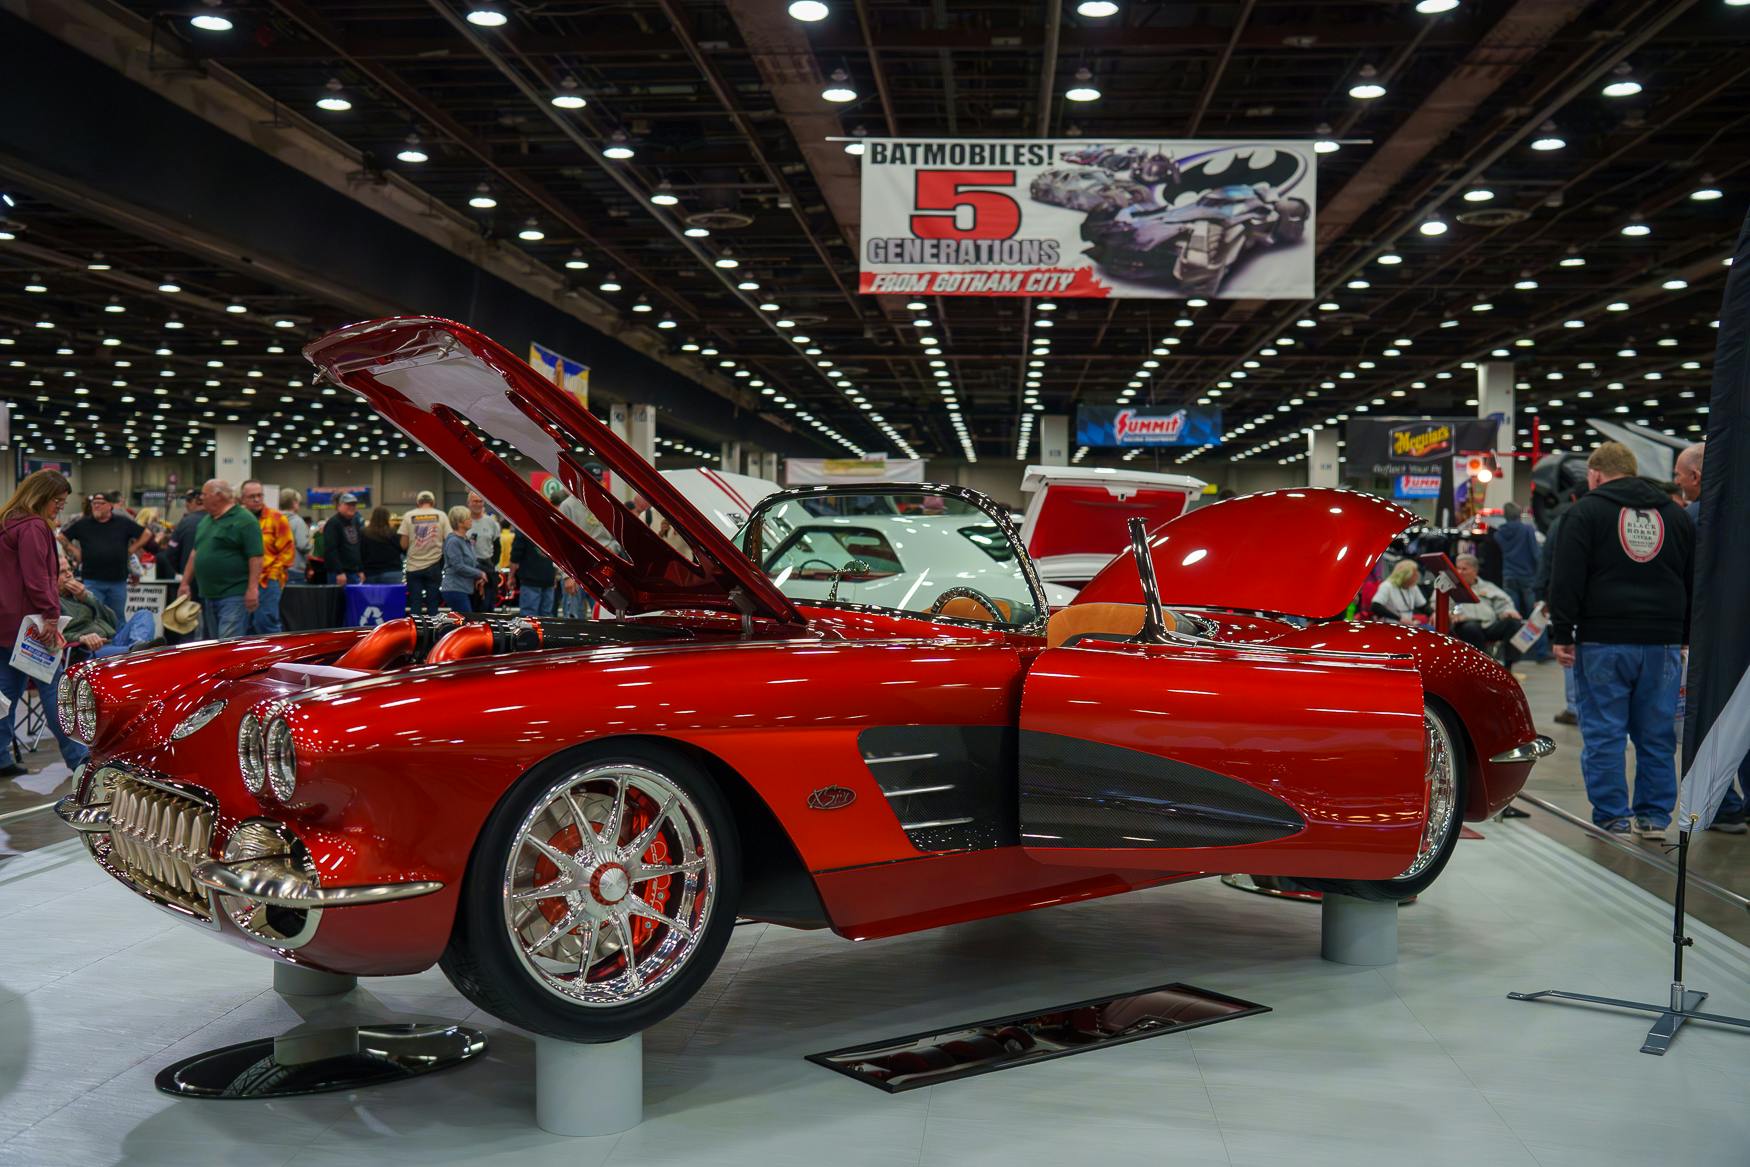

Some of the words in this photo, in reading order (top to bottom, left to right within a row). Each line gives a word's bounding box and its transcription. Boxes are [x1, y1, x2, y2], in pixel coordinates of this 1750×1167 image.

[870, 143, 1056, 165] BATMOBILES!
[910, 169, 1021, 240] 5
[867, 238, 1061, 265] GENERATIONS
[870, 273, 931, 292] FROM
[932, 273, 1025, 292] GOTHAM
[1025, 272, 1076, 292] CITY
